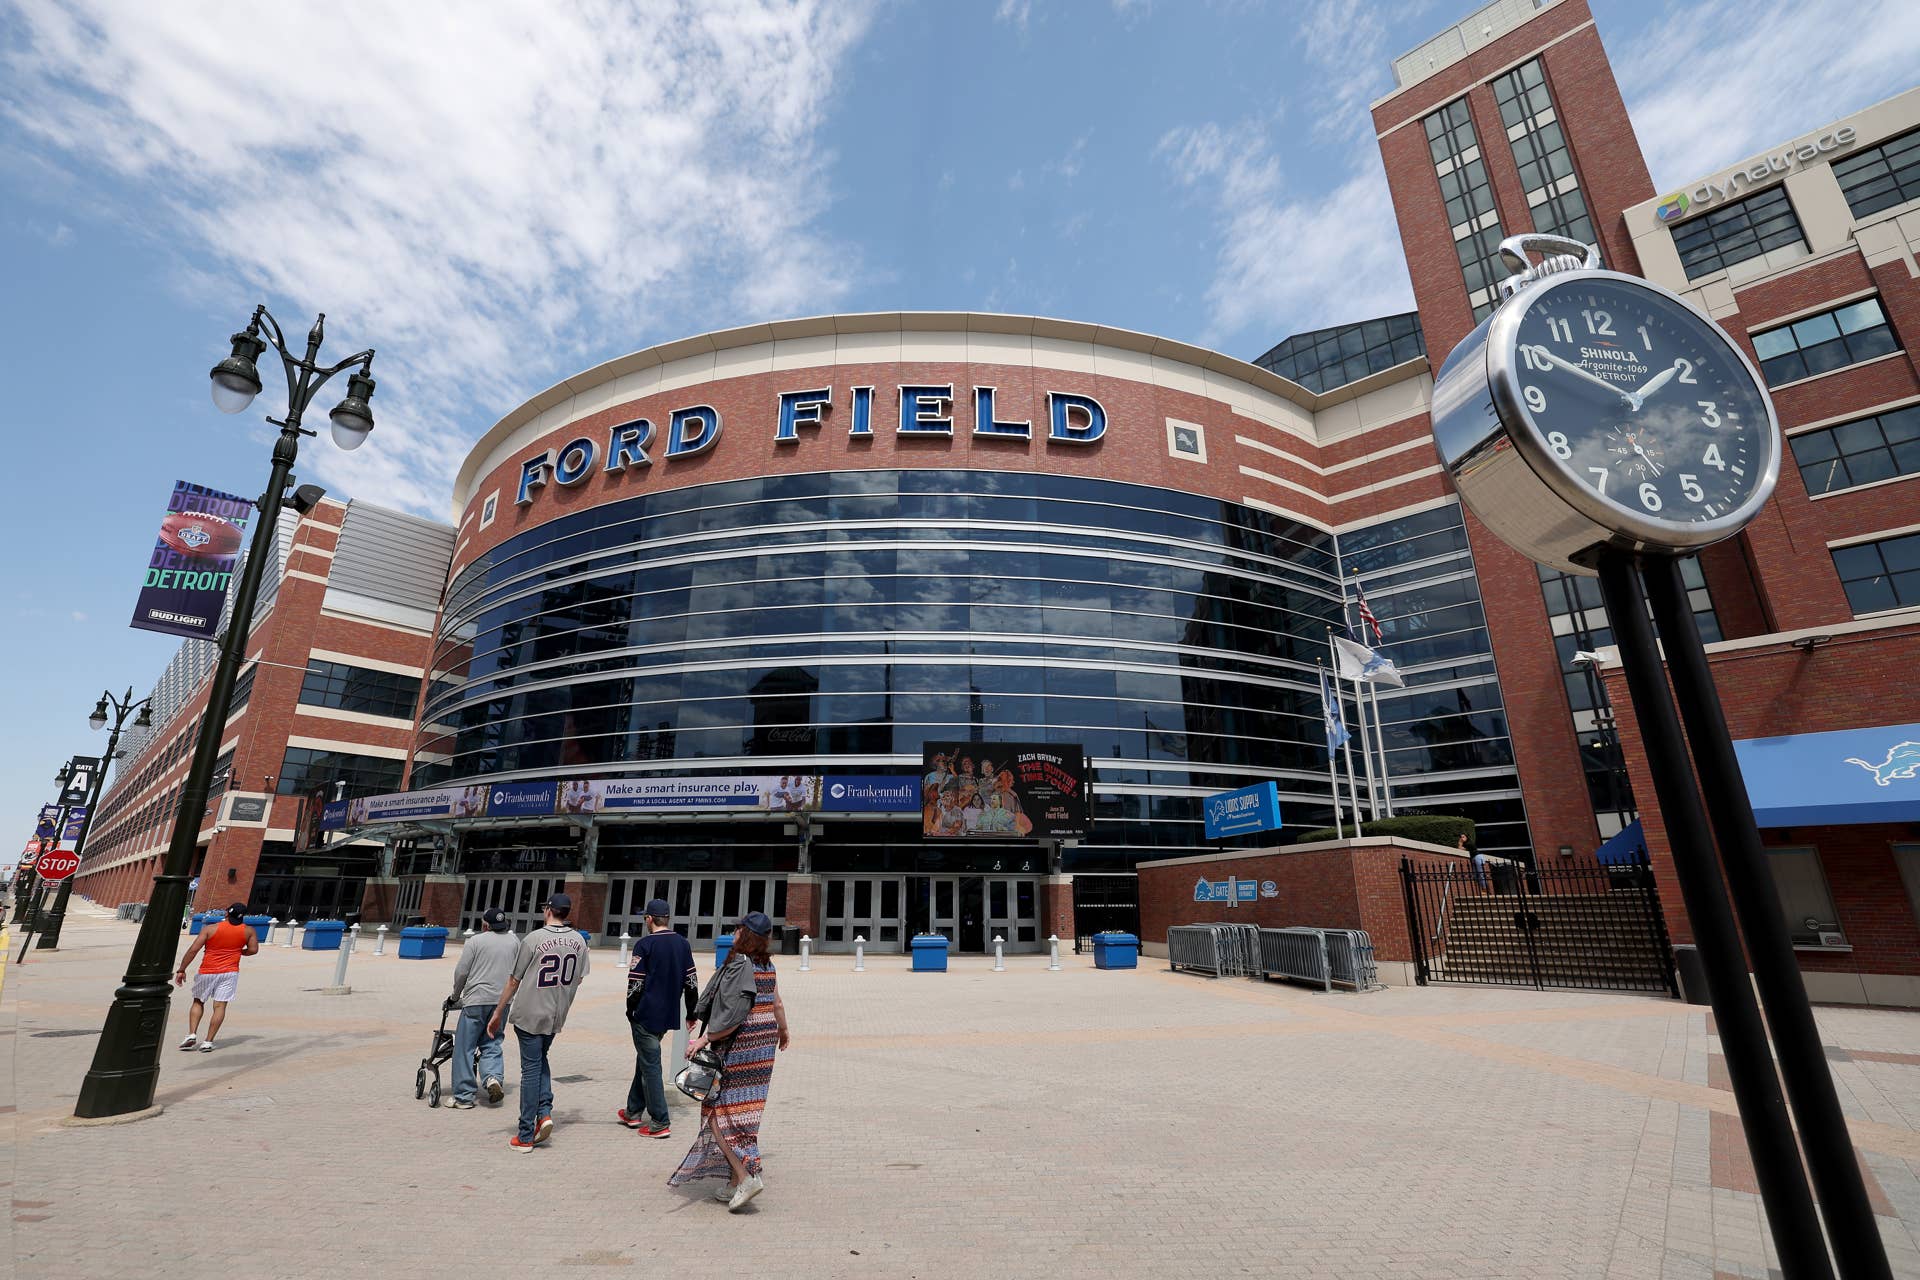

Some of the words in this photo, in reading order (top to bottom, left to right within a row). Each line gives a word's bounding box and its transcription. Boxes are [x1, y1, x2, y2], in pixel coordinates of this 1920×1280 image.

[1692, 125, 1856, 202] dynatrace
[1547, 317, 1574, 344] 11
[1581, 310, 1617, 336] 12
[1637, 326, 1653, 351] 1
[1520, 344, 1554, 372] 10
[1580, 346, 1639, 363] SHINOLA
[1576, 360, 1648, 374] Argonite-1069
[1595, 371, 1636, 382] DETROIT
[1674, 358, 1697, 384] 2
[1523, 386, 1547, 413] 9
[1697, 401, 1721, 428] 3
[514, 404, 724, 506] FORD
[774, 382, 1109, 447] FIELD
[1548, 432, 1572, 460] 8
[1702, 443, 1726, 471] 4
[1588, 467, 1609, 494] 7
[1679, 474, 1704, 502] 5
[168, 492, 251, 519] DETROIT
[1639, 482, 1662, 511] 6
[143, 568, 233, 592] DETROIT
[150, 610, 173, 621] BUD
[173, 613, 205, 626] LIGHT
[75, 764, 94, 772] GATE
[1017, 753, 1036, 762] ZACH
[1018, 761, 1042, 772] THE
[67, 772, 88, 792] A
[606, 784, 633, 794] Make
[645, 783, 675, 793] smart
[678, 782, 730, 793] insurance
[733, 781, 760, 794] play.
[847, 784, 912, 797] Frankenmuth
[370, 800, 384, 808] Make
[388, 798, 404, 807] smart
[406, 795, 435, 805] insurance
[1239, 792, 1260, 811] SUPPLY
[40, 858, 77, 871] STOP
[1216, 886, 1228, 897] GATE
[536, 938, 582, 954] TORKELSON
[537, 952, 578, 988] 20
